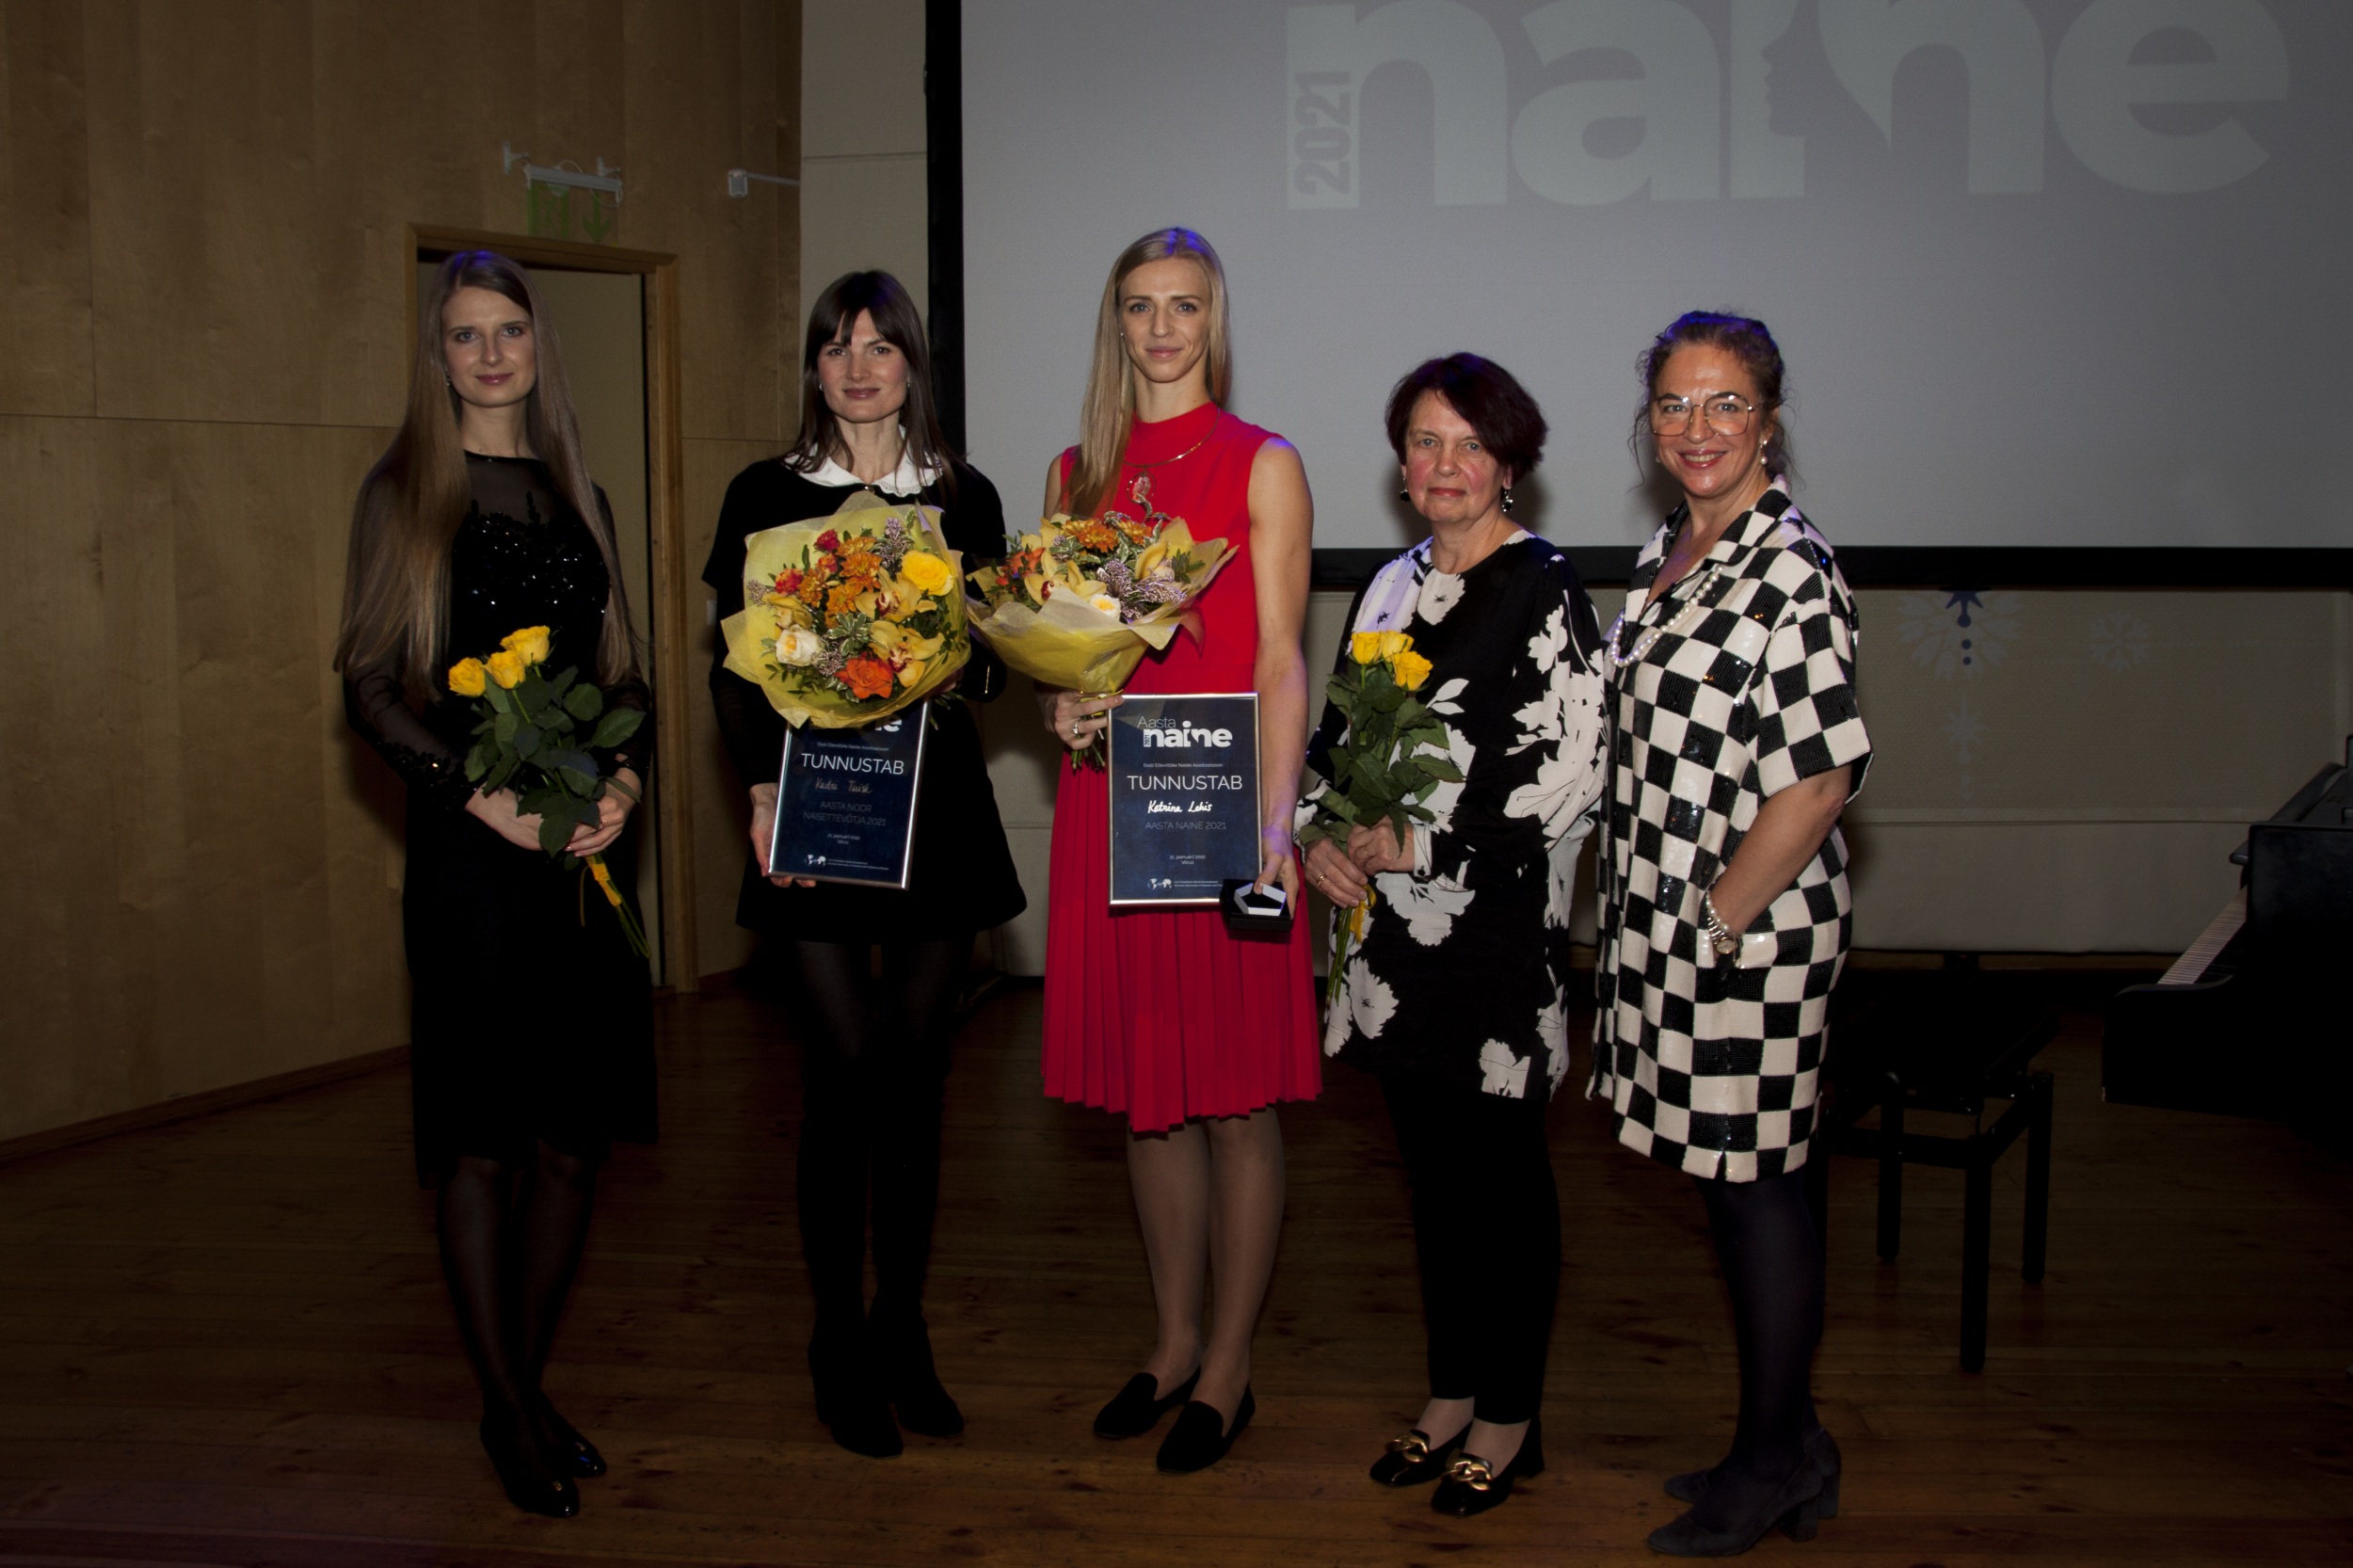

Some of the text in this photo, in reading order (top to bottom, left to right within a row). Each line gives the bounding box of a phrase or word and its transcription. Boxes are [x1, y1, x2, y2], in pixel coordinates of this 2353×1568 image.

[1293, 70, 1352, 197] 2021
[1137, 715, 1176, 728] Aasta
[1144, 721, 1233, 747] naine
[801, 753, 904, 776] TUNNUSTAB
[814, 777, 839, 791] Kadri
[1127, 776, 1243, 790] TUNNUSTAB
[820, 801, 872, 813] AASTA NOOR
[1147, 800, 1183, 813] Katrina
[866, 817, 887, 826] 2021
[1144, 821, 1226, 830] AASTA NAINE 2021
